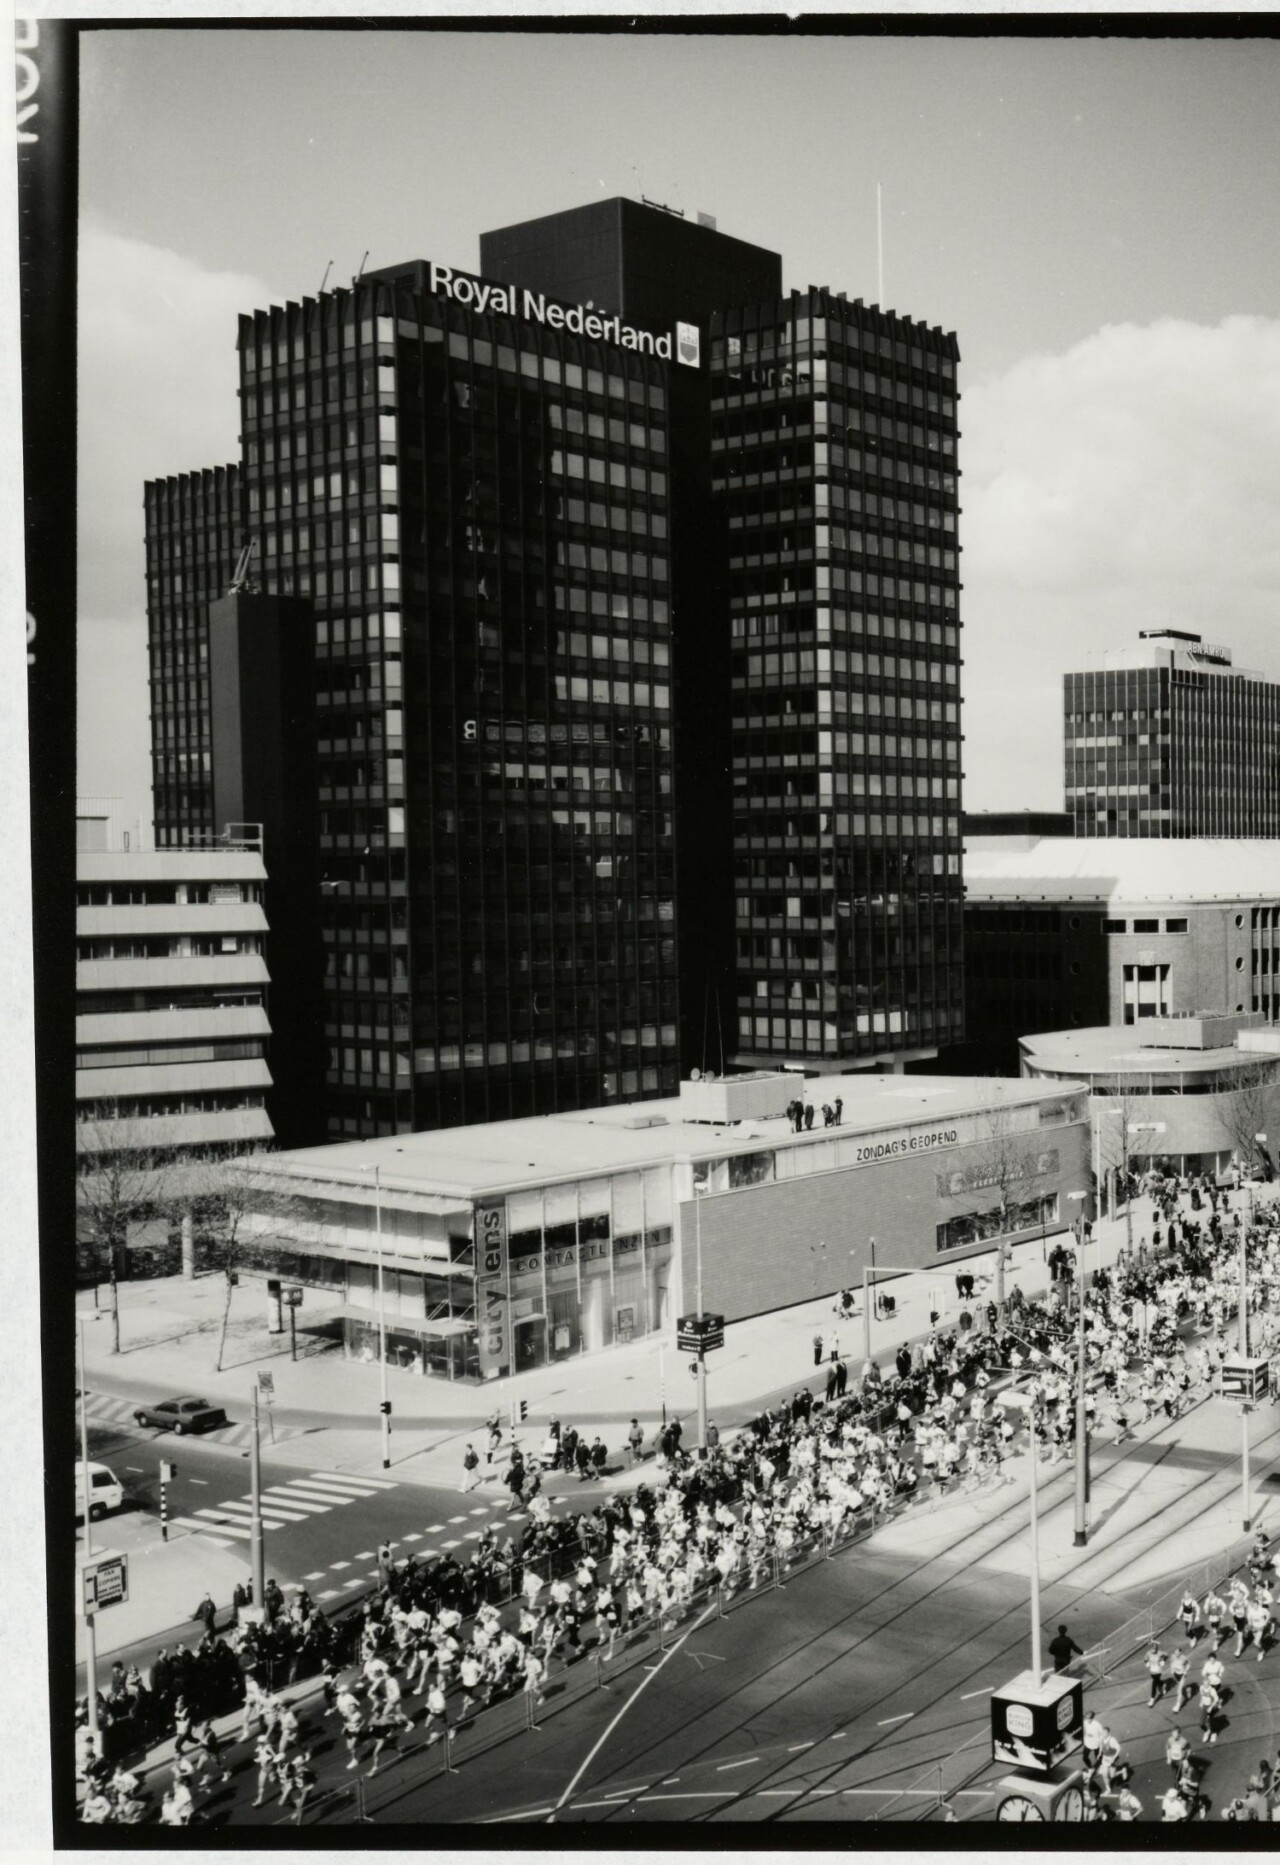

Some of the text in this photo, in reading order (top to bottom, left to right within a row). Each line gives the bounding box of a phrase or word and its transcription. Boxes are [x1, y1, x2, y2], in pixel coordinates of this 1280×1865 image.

[430, 261, 672, 360] Royal Nederland
[857, 1130, 957, 1161] ZONDAG'S GEOPEND
[479, 1210, 508, 1356] city lens
[1008, 1720, 1032, 1731] KING
